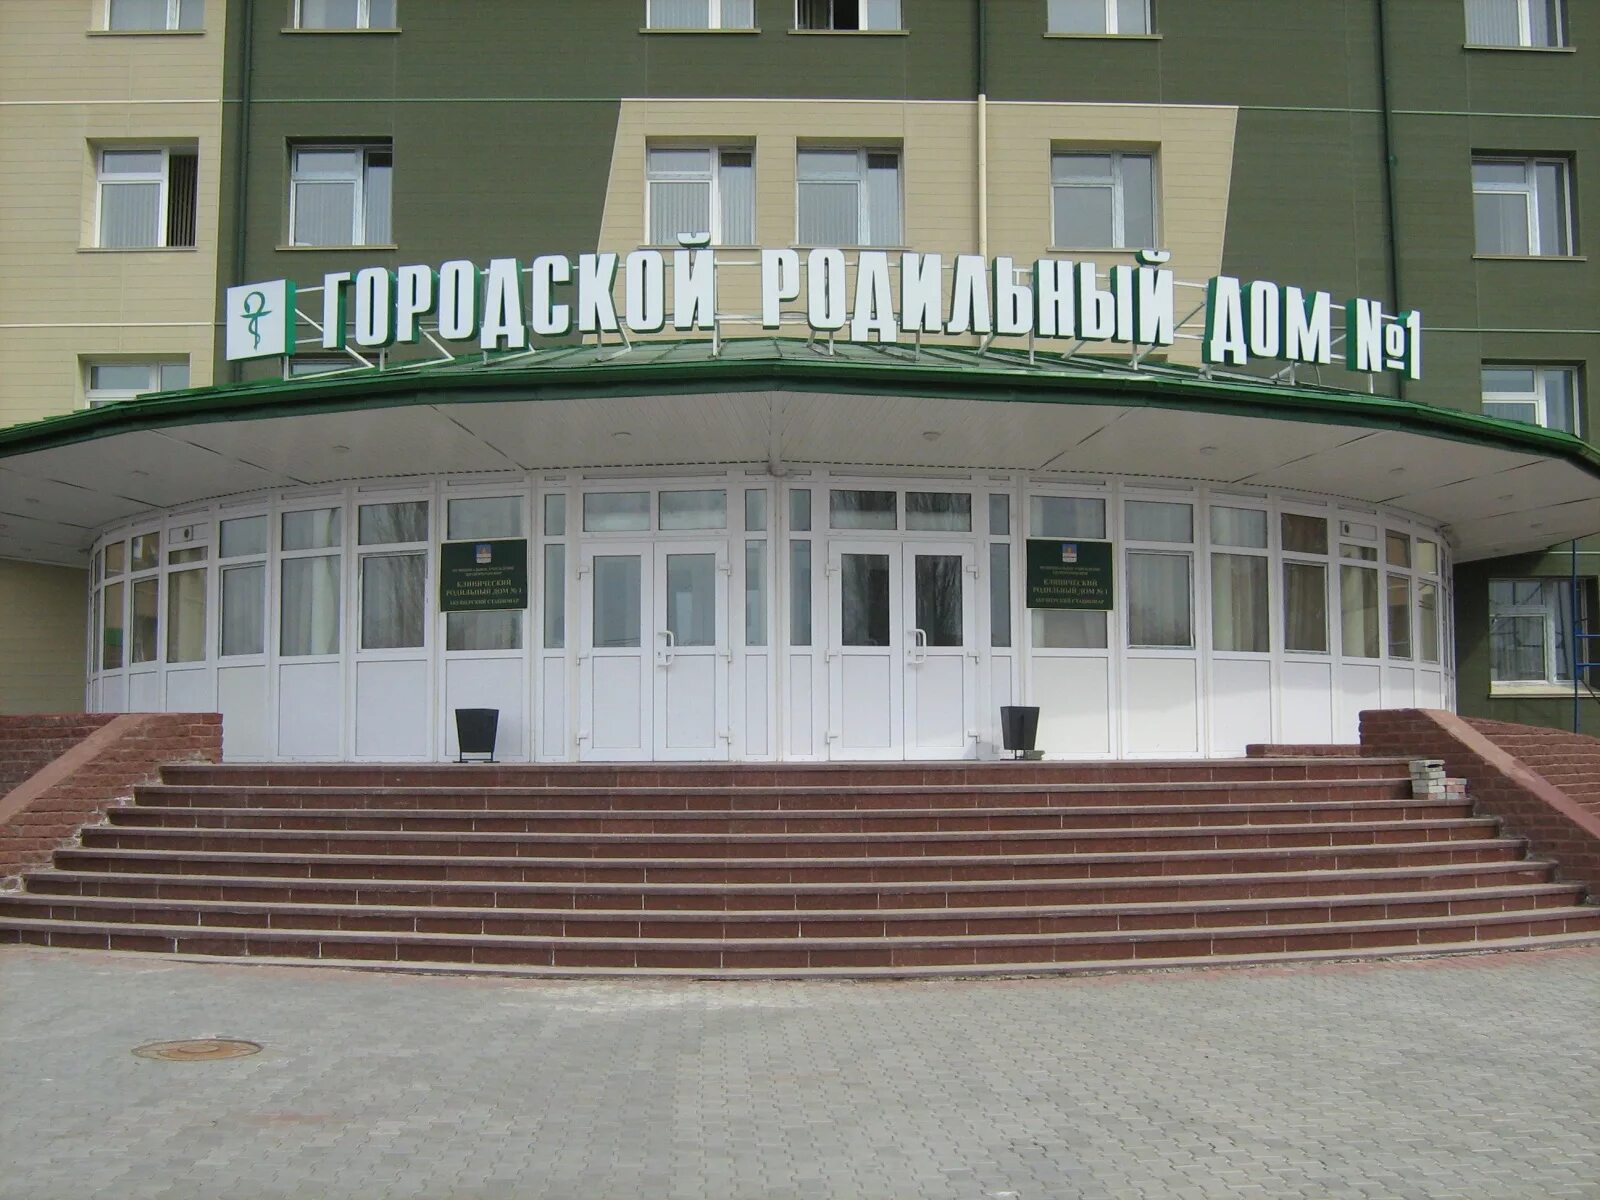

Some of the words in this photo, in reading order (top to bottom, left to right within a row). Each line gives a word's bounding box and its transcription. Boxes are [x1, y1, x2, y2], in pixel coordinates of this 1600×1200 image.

[323, 232, 716, 350] ГОРОДСКОЙ
[761, 249, 1174, 347] РОДИЛЬНЫЙ
[1205, 275, 1332, 366] ДОМ
[1347, 297, 1421, 381] №1
